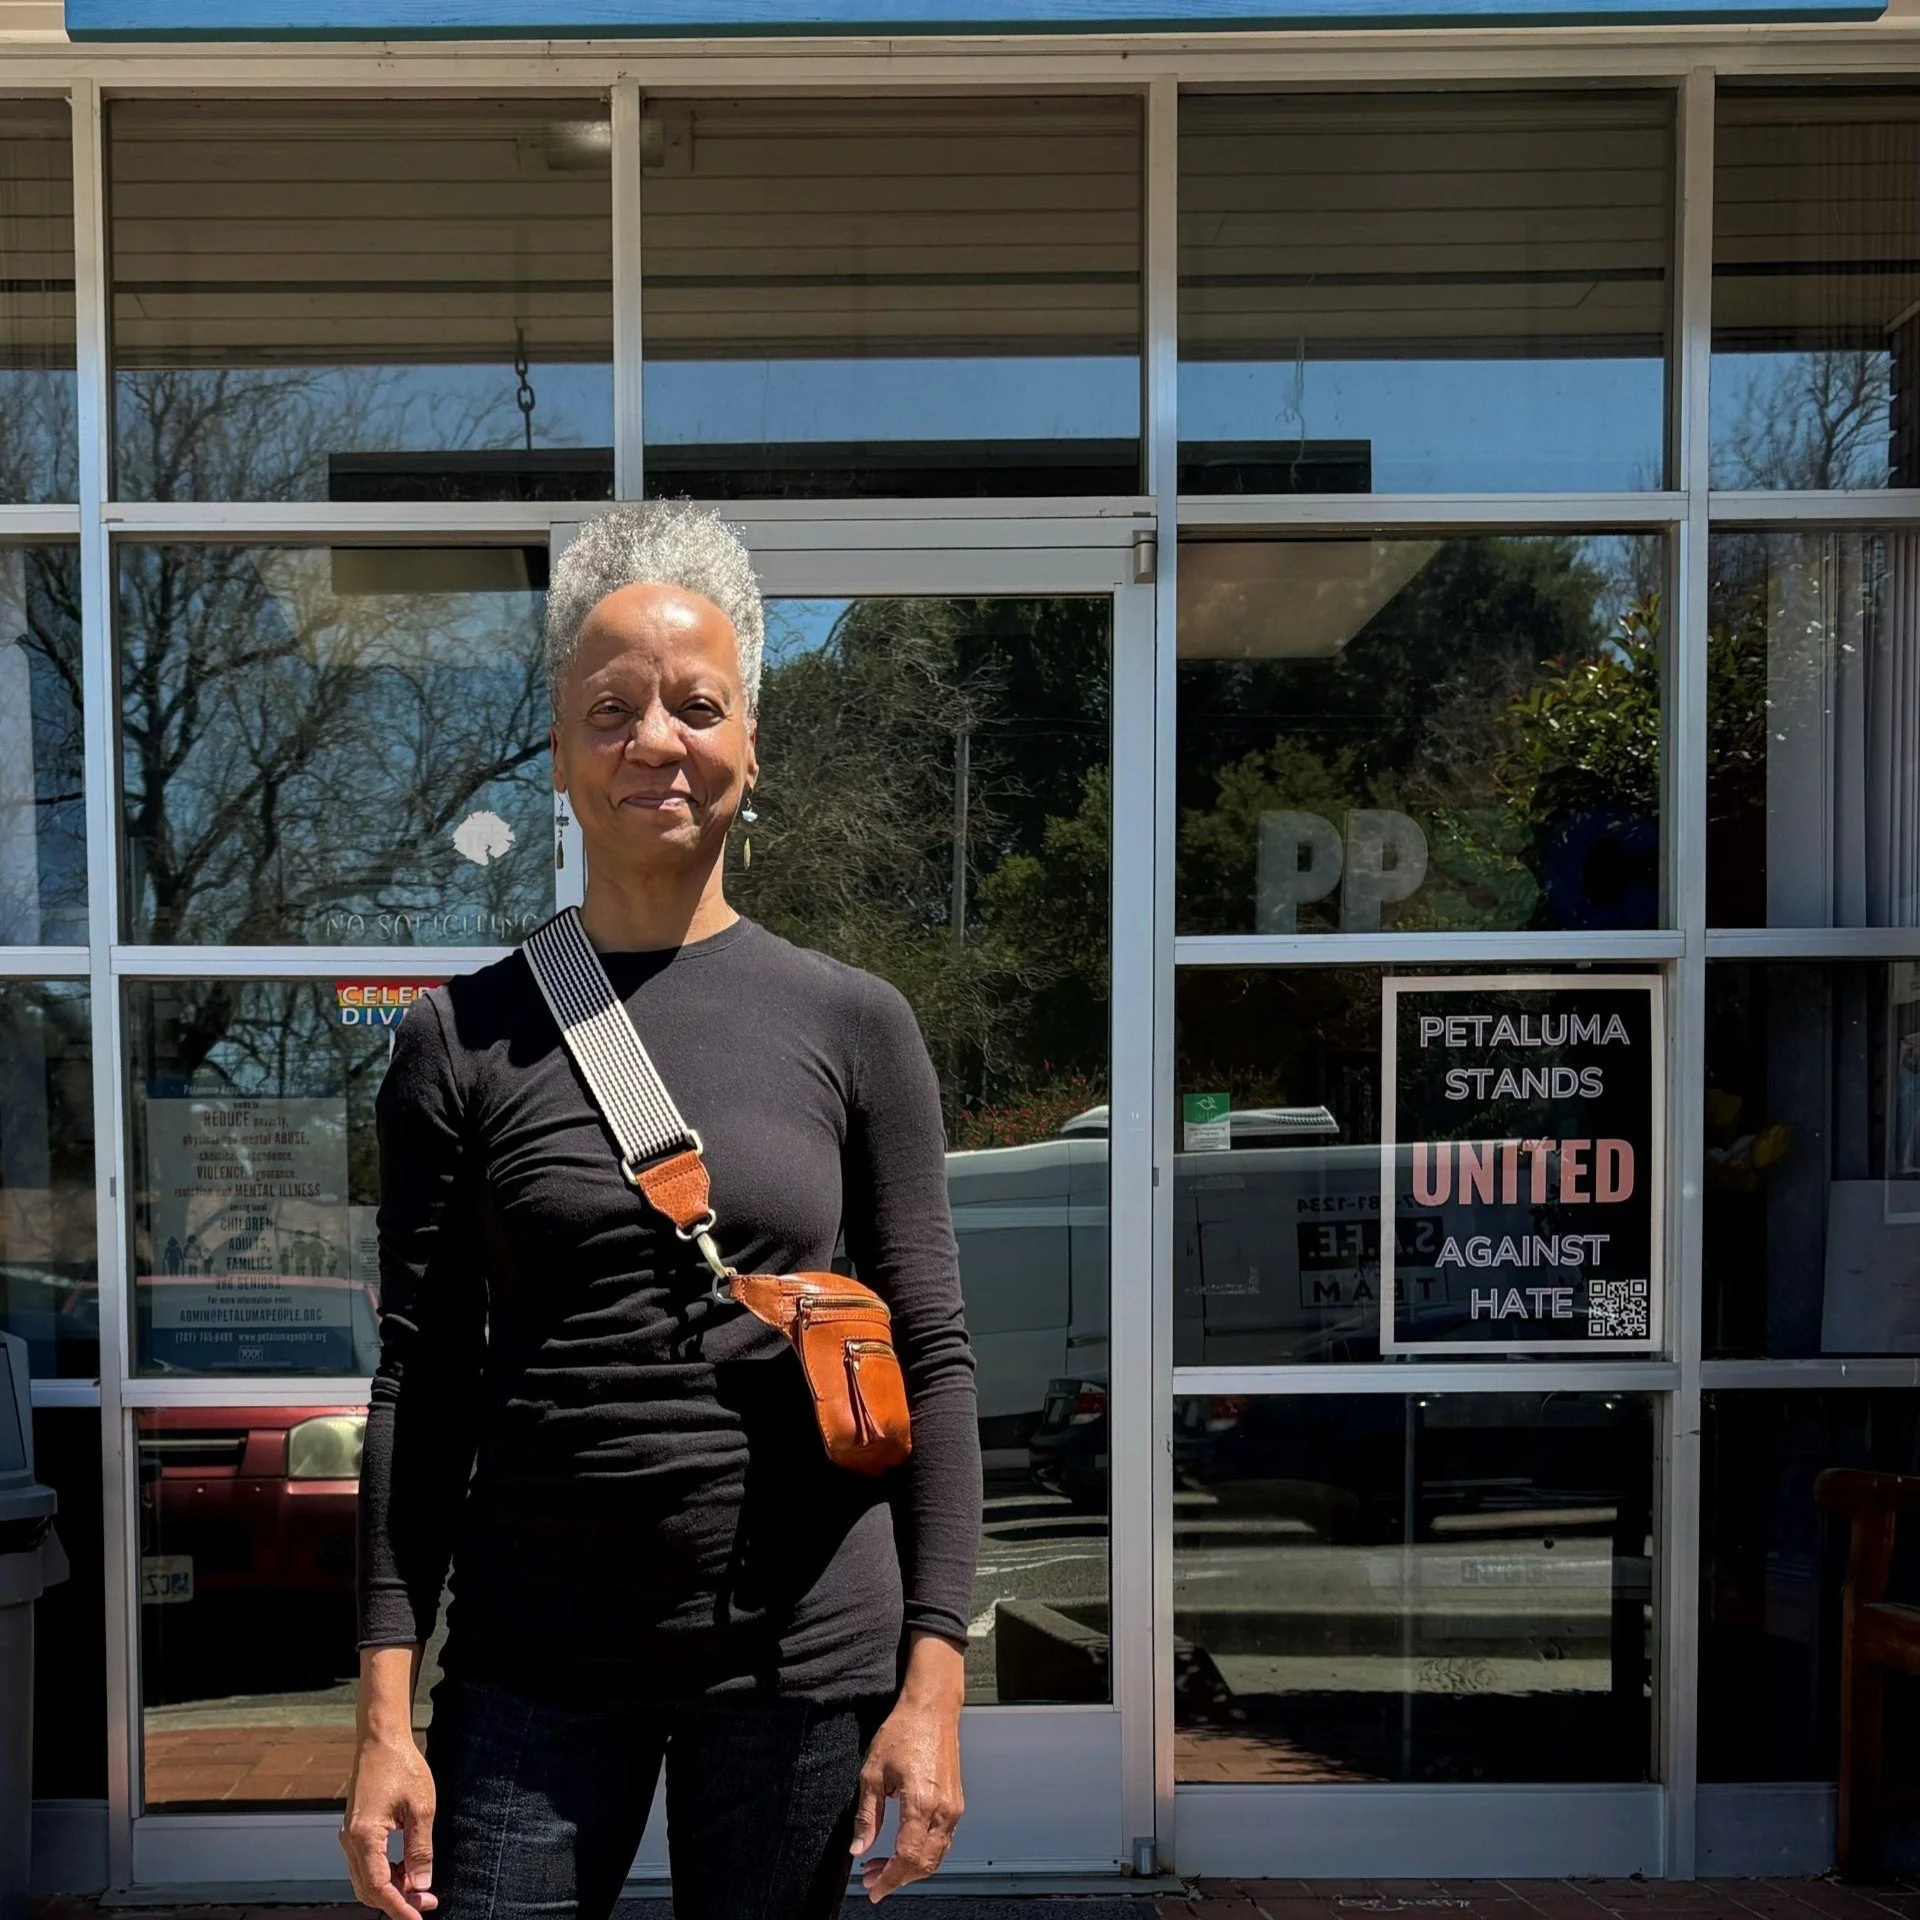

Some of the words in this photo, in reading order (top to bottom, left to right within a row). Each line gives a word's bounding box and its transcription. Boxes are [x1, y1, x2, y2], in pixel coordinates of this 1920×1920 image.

[1419, 1013, 1631, 1048] PETALUMA
[1444, 1067, 1604, 1101] STANDS
[203, 1110, 250, 1127] REDUCE
[274, 1131, 310, 1146] ABUSE,
[1412, 1138, 1635, 1207] UNITED
[235, 1183, 275, 1198] MENTAL
[279, 1183, 321, 1198] ILLNESS
[228, 1238, 270, 1253] ADULTS,
[1434, 1235, 1611, 1268] AGAINST
[226, 1257, 272, 1271] FAMILIES
[1470, 1287, 1574, 1319] HATE
[180, 1308, 323, 1323] ADMIN@PETALUMAPEOPLE.ORG
